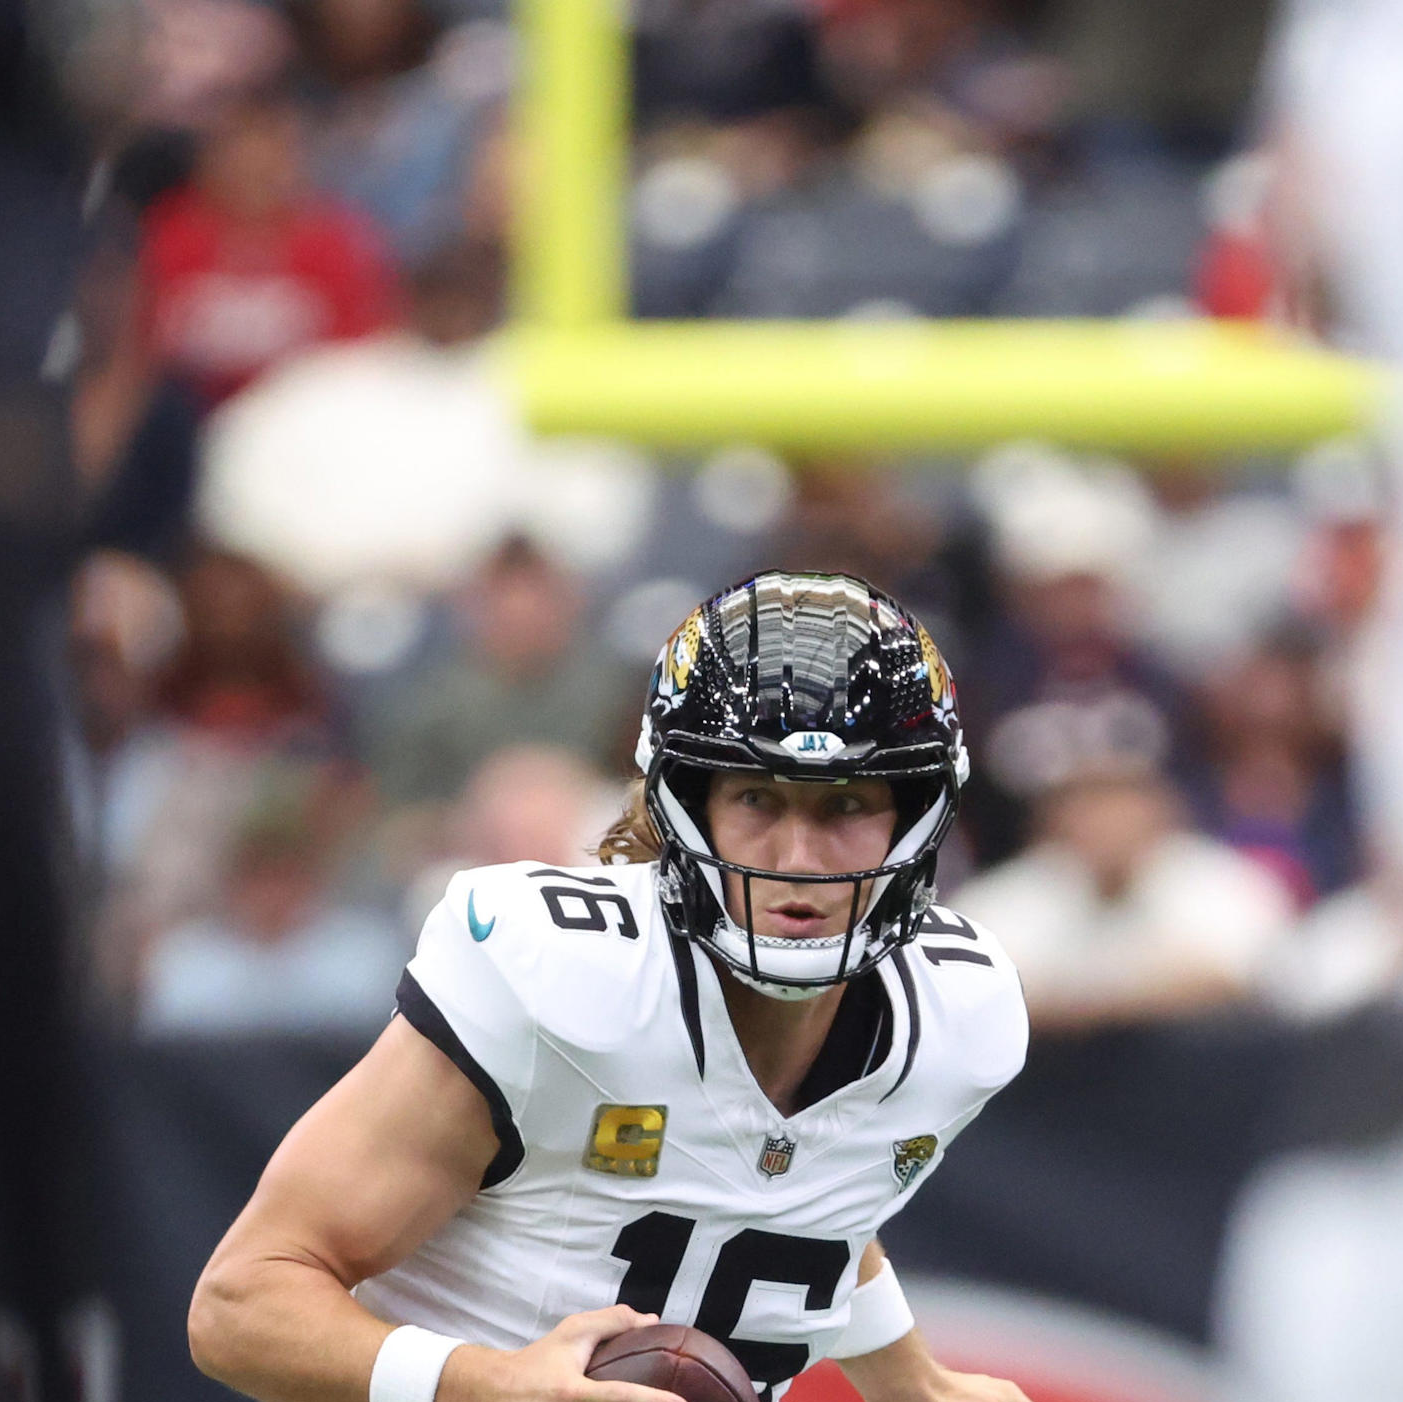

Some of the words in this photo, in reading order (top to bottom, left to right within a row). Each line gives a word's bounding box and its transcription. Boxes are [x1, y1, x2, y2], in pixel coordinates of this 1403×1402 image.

[797, 734, 828, 752] JAX
[525, 868, 640, 941] 16
[594, 1107, 663, 1161] C
[763, 1153, 788, 1172] NFL
